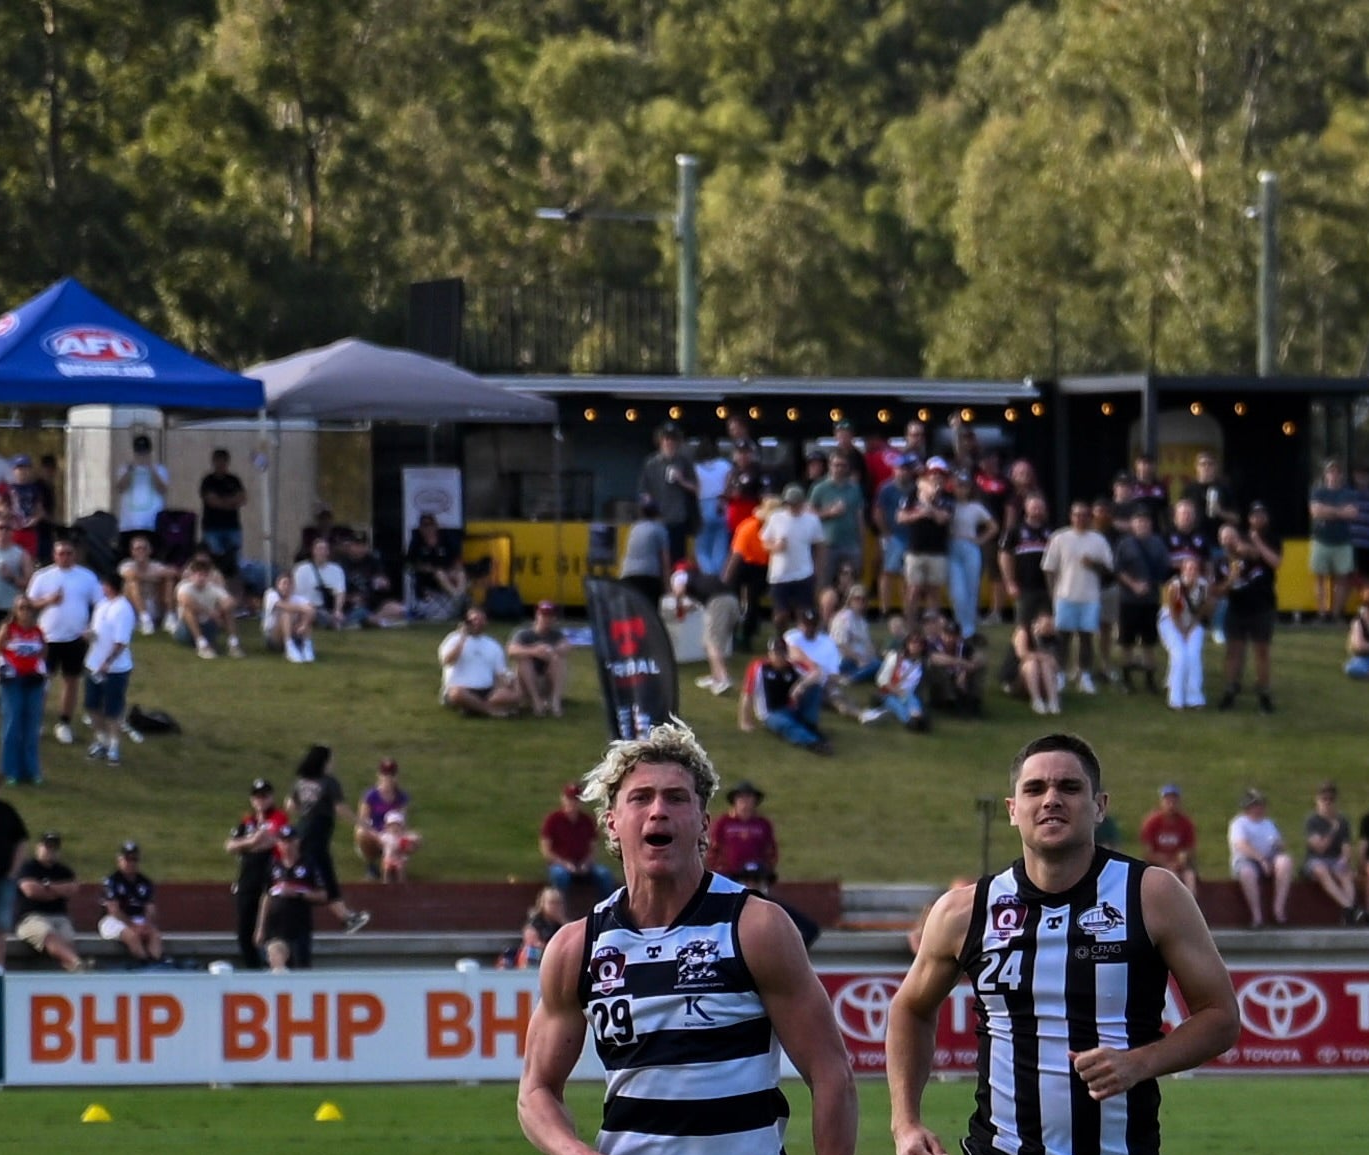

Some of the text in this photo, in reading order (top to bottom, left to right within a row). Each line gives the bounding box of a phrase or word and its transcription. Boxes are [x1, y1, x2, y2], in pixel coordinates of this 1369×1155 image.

[56, 338, 140, 358] AFL
[977, 950, 1024, 992] 24
[28, 994, 184, 1063] BHP
[222, 992, 385, 1061] BHP
[425, 990, 530, 1059] BH
[592, 998, 634, 1044] 29
[1243, 1048, 1302, 1062] TOYOTA
